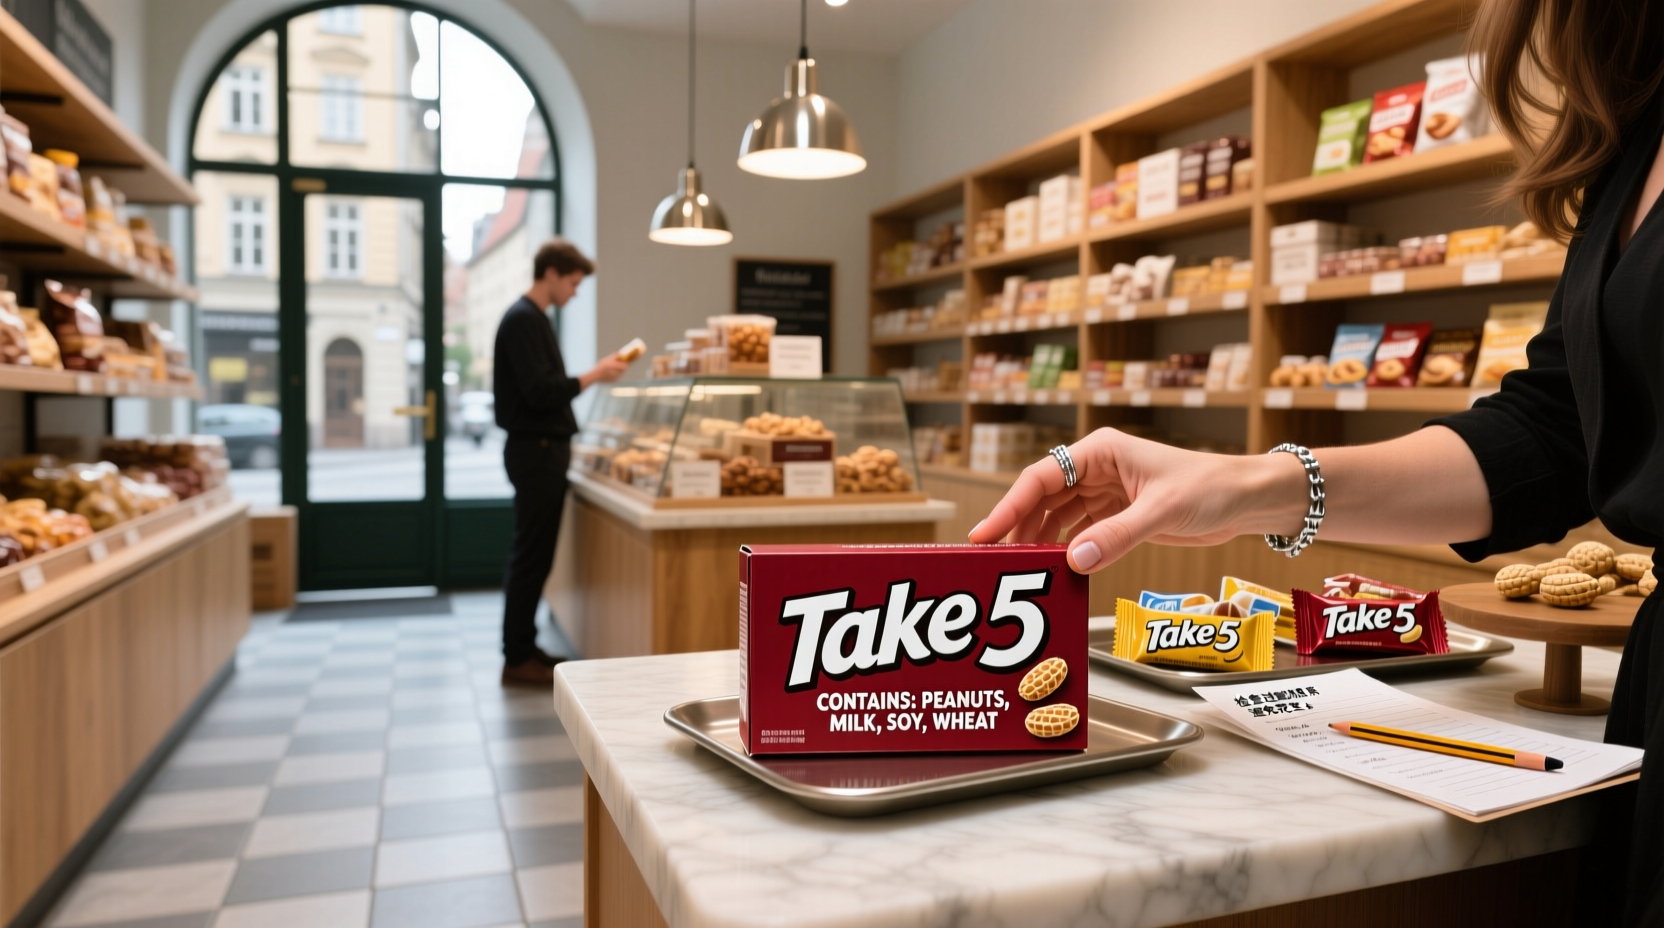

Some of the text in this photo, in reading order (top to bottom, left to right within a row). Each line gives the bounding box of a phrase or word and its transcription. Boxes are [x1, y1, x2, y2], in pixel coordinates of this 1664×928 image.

[780, 580, 979, 689] Take
[977, 570, 1049, 670] 5
[1146, 619, 1241, 652] Take 5
[1322, 602, 1417, 639] Take 5
[816, 689, 1010, 712] CONTAINS: PEANUTS,
[829, 711, 999, 735] MILK, SOY, WHEAT
